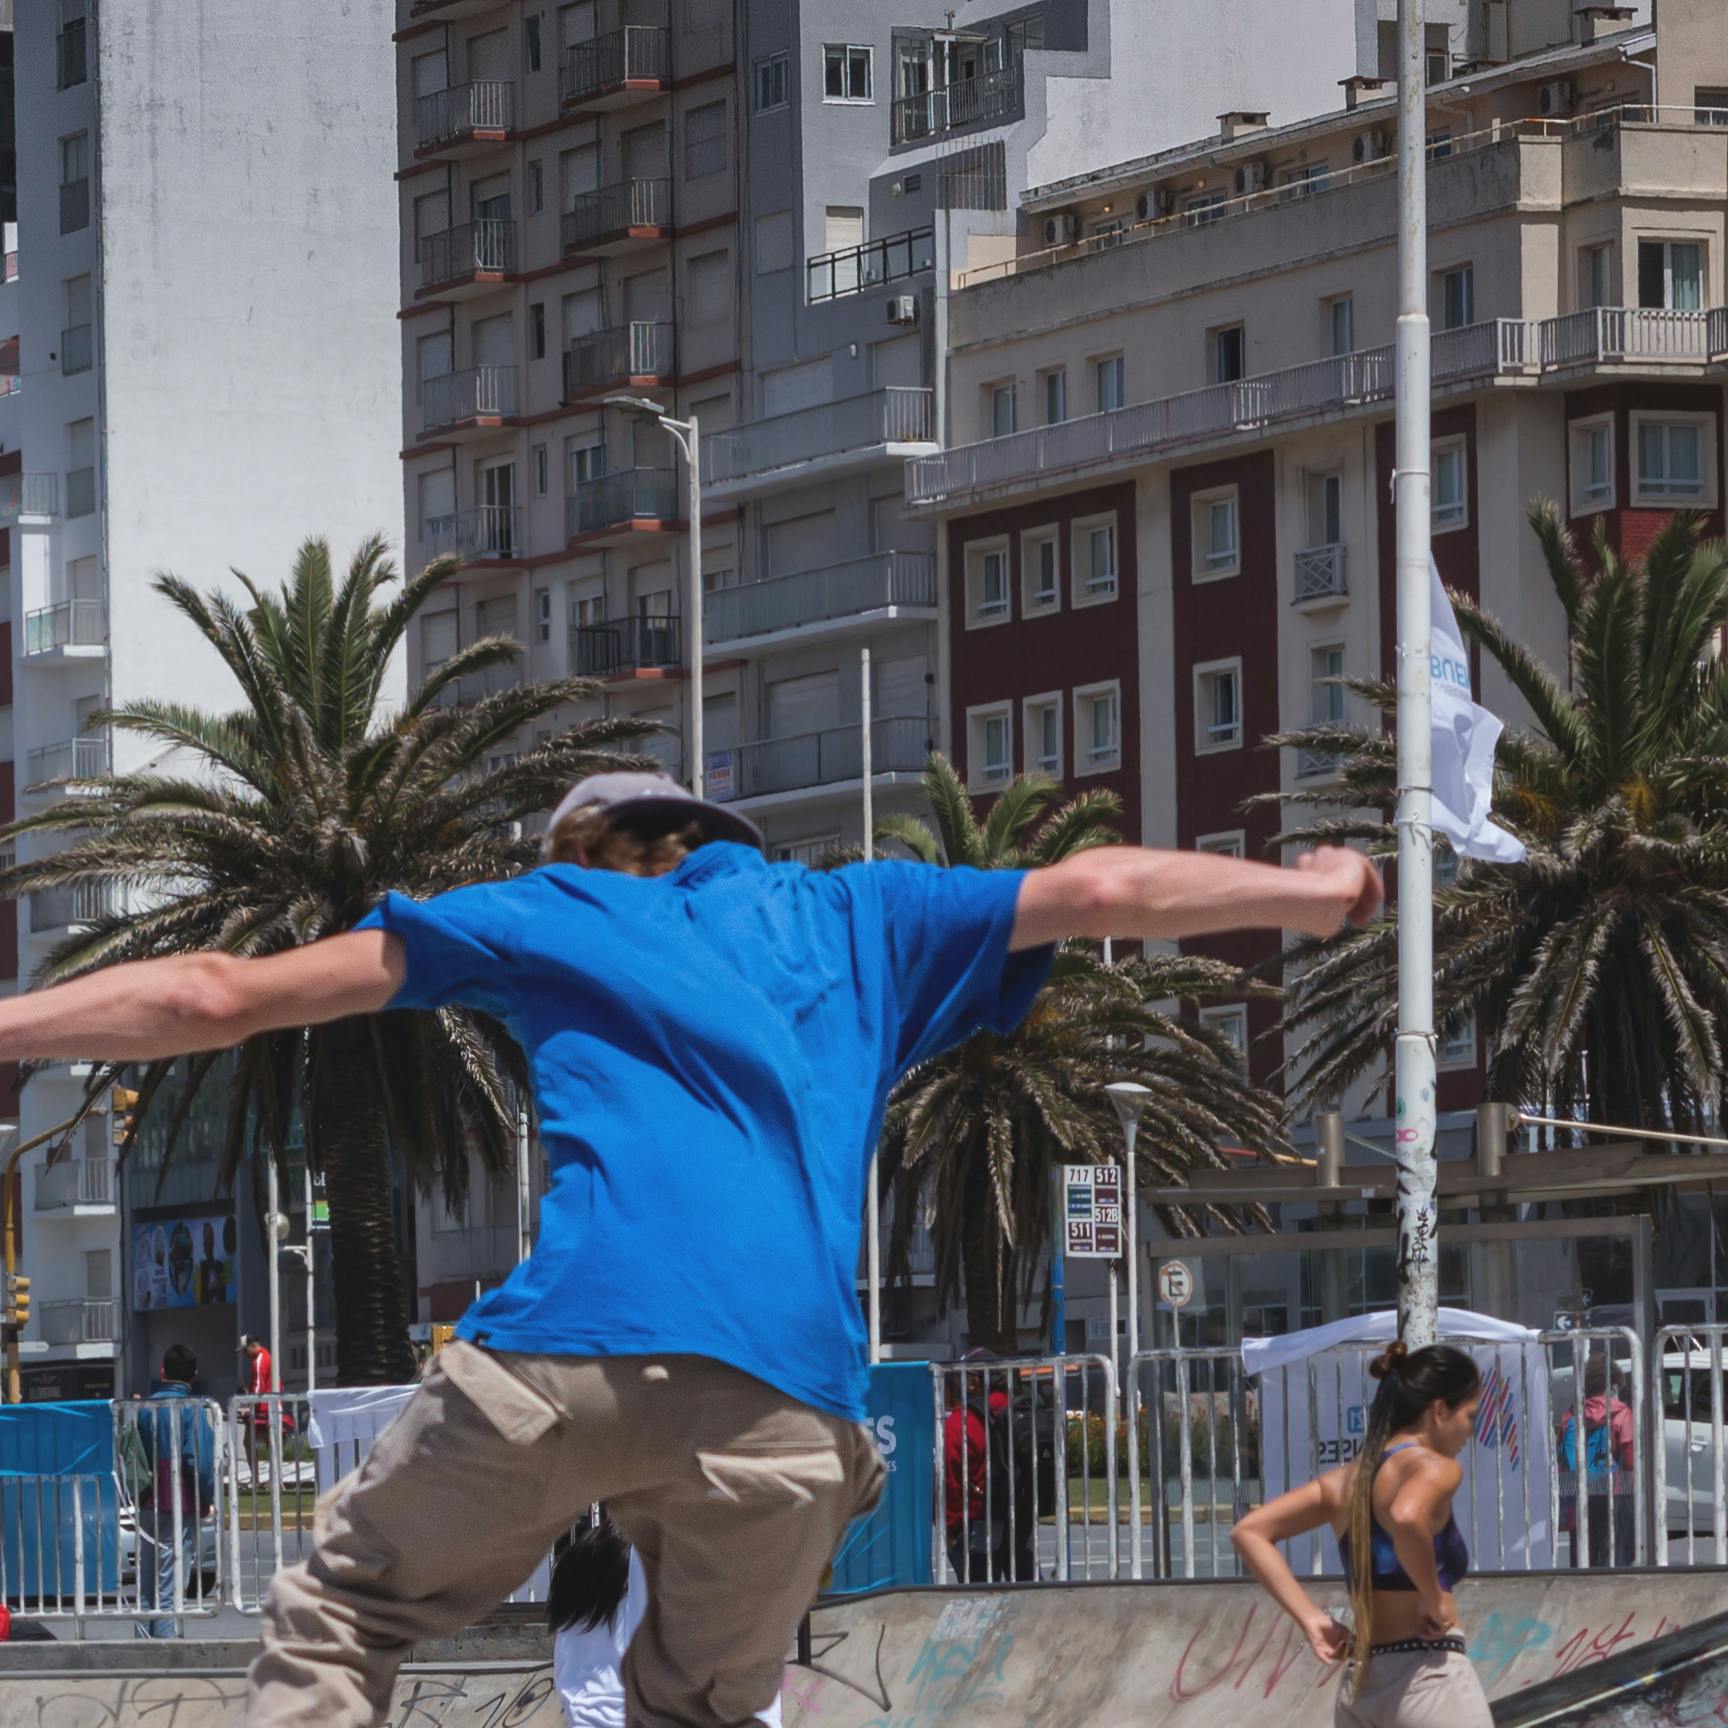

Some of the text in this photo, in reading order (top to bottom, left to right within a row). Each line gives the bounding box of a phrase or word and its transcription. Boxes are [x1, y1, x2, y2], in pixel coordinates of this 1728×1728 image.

[1069, 1169, 1089, 1182] 717
[1096, 1169, 1117, 1183] 512
[1071, 1223, 1091, 1238] 511
